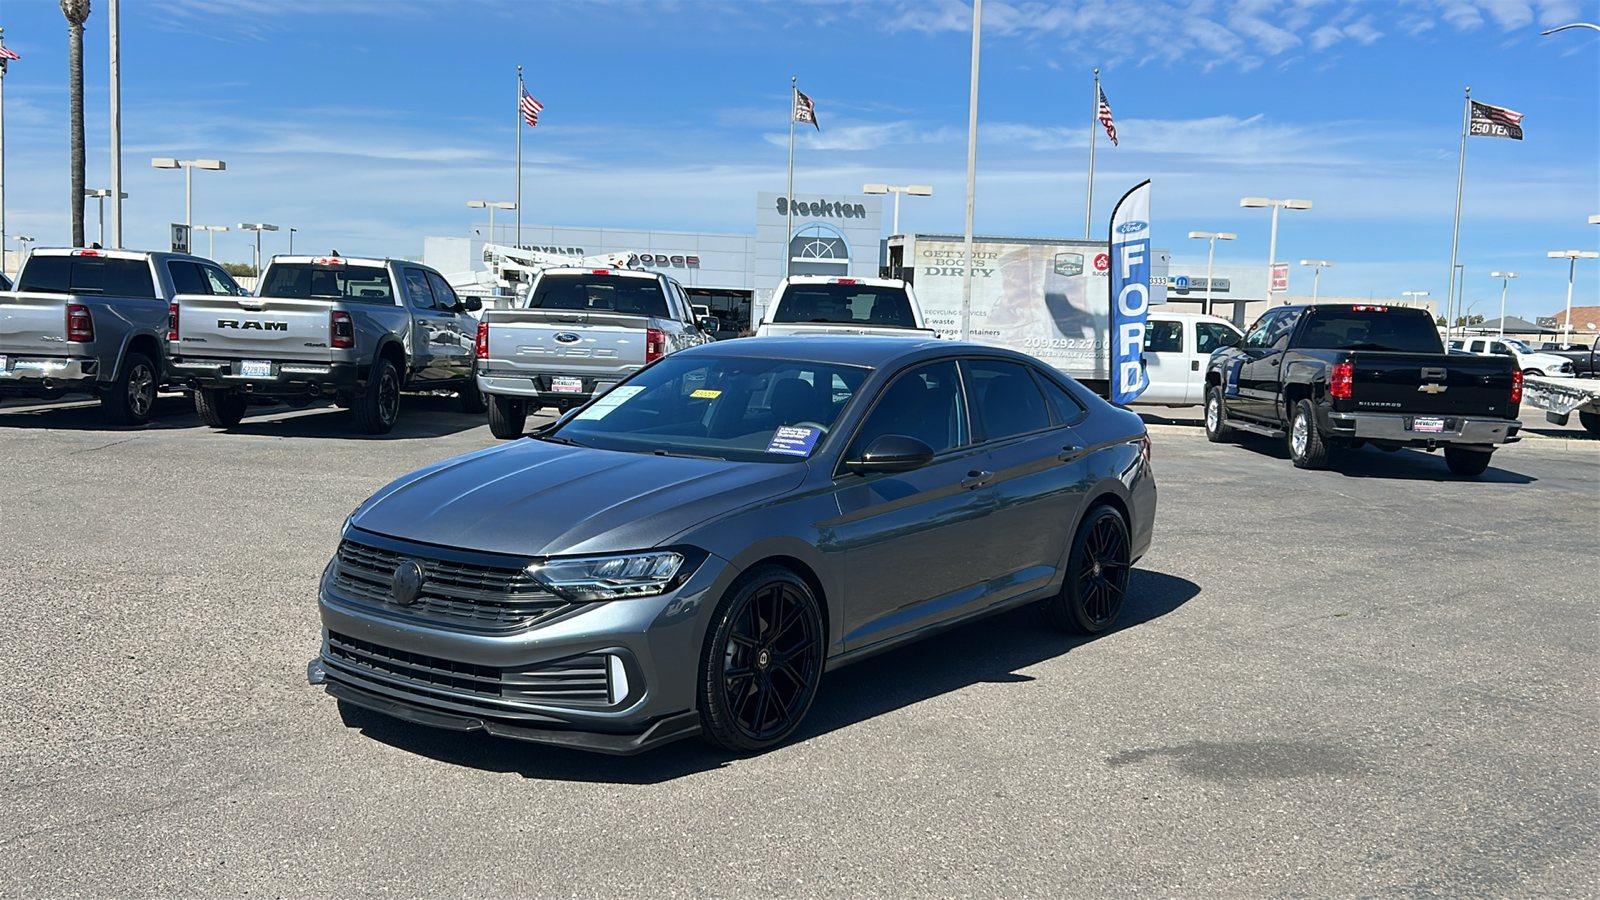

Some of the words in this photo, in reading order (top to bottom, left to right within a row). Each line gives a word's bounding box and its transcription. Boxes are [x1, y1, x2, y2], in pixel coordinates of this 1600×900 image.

[796, 110, 811, 120] 250
[1471, 123, 1489, 133] 250
[1492, 124, 1521, 137] YEARS
[1122, 222, 1146, 233] Ford
[923, 250, 953, 258] GET
[1150, 277, 1167, 285] 3333
[924, 317, 955, 325] E-waste
[1118, 243, 1148, 394] FORD
[217, 319, 288, 331] RAM
[1024, 338, 1109, 351] 209.292.2700
